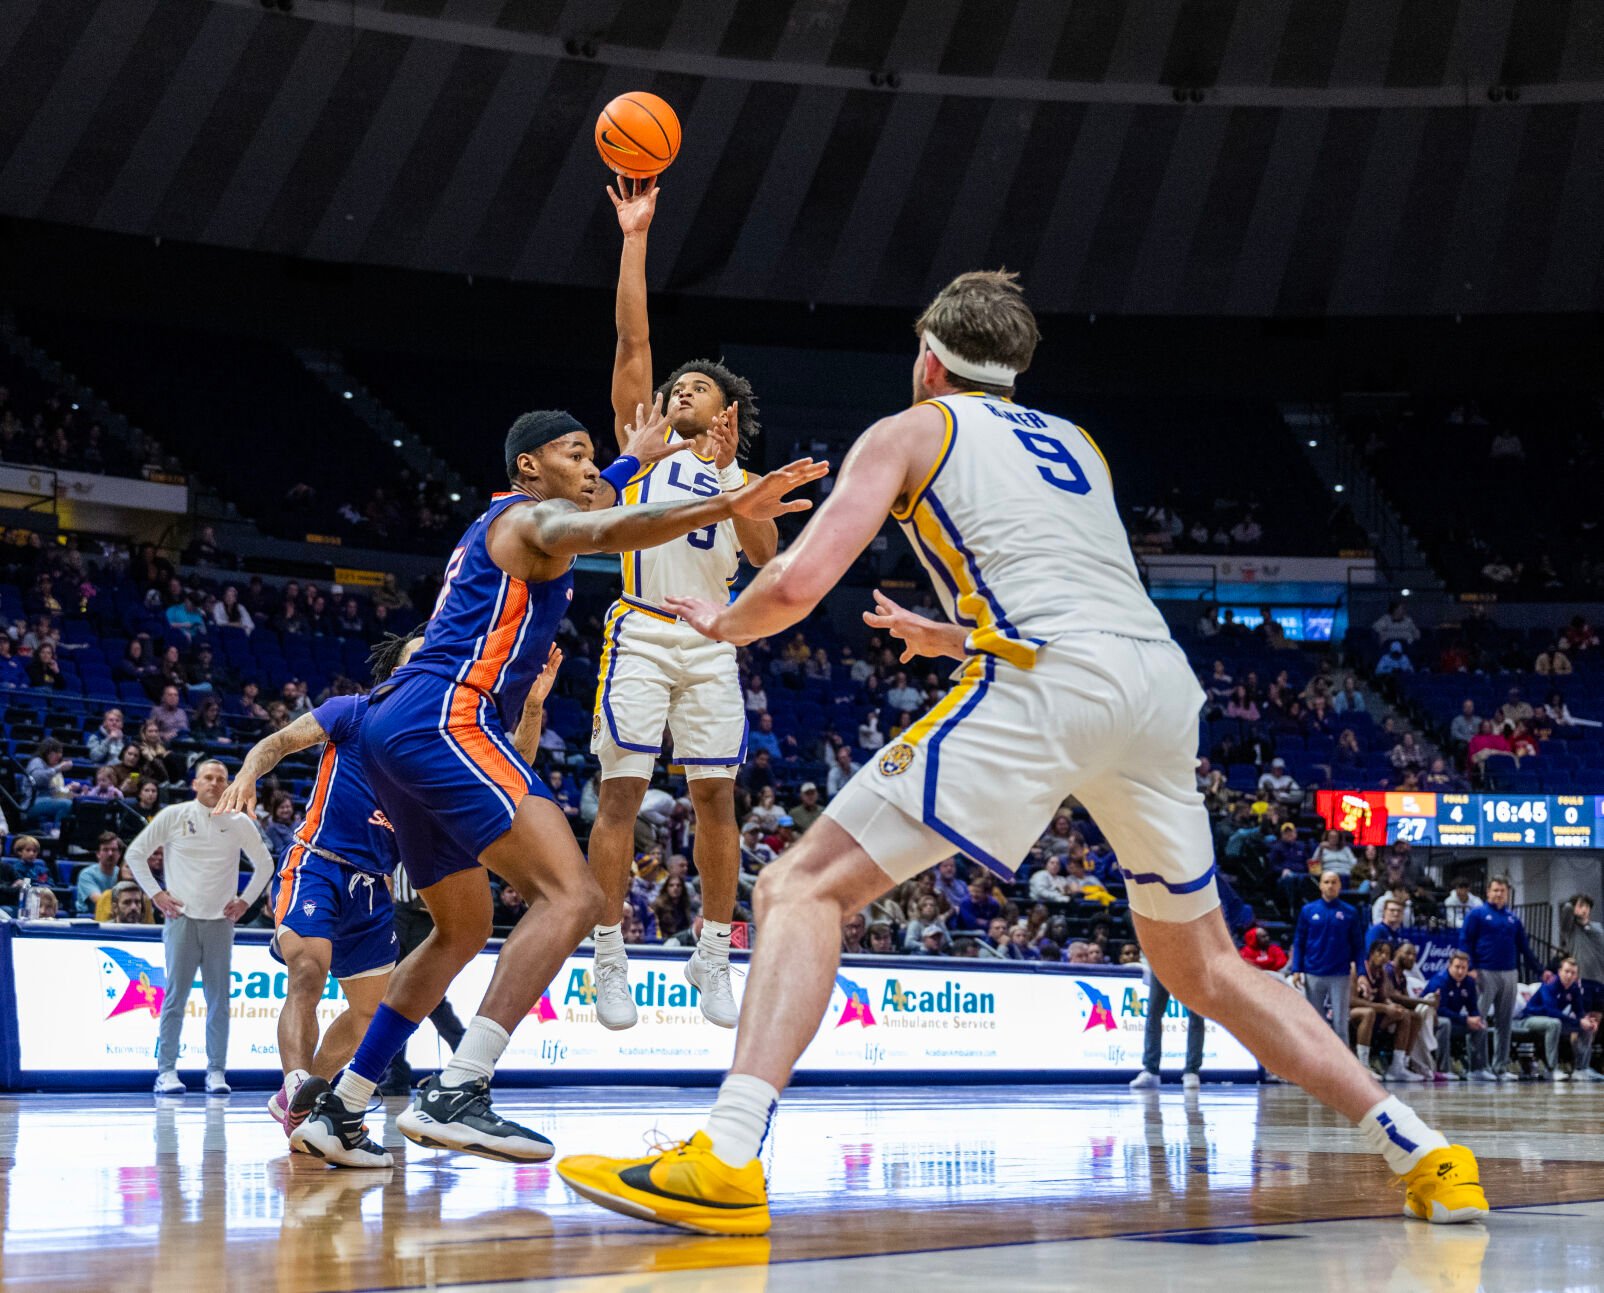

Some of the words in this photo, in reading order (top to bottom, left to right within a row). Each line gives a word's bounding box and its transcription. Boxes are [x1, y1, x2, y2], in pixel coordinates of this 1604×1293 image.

[1012, 428, 1092, 495] 9
[668, 461, 724, 497] LS
[1450, 805, 1463, 823] 4
[1483, 800, 1547, 823] 16:45
[1565, 807, 1578, 824] 0
[1397, 817, 1427, 842] 27
[1525, 828, 1535, 843] 2
[564, 968, 702, 1007] Adian
[881, 979, 994, 1013] Acadian
[883, 1014, 948, 1029] Ambulance
[953, 1015, 996, 1030] Service
[541, 1040, 568, 1065] life
[865, 1042, 886, 1066] life
[1108, 1045, 1126, 1065] life
